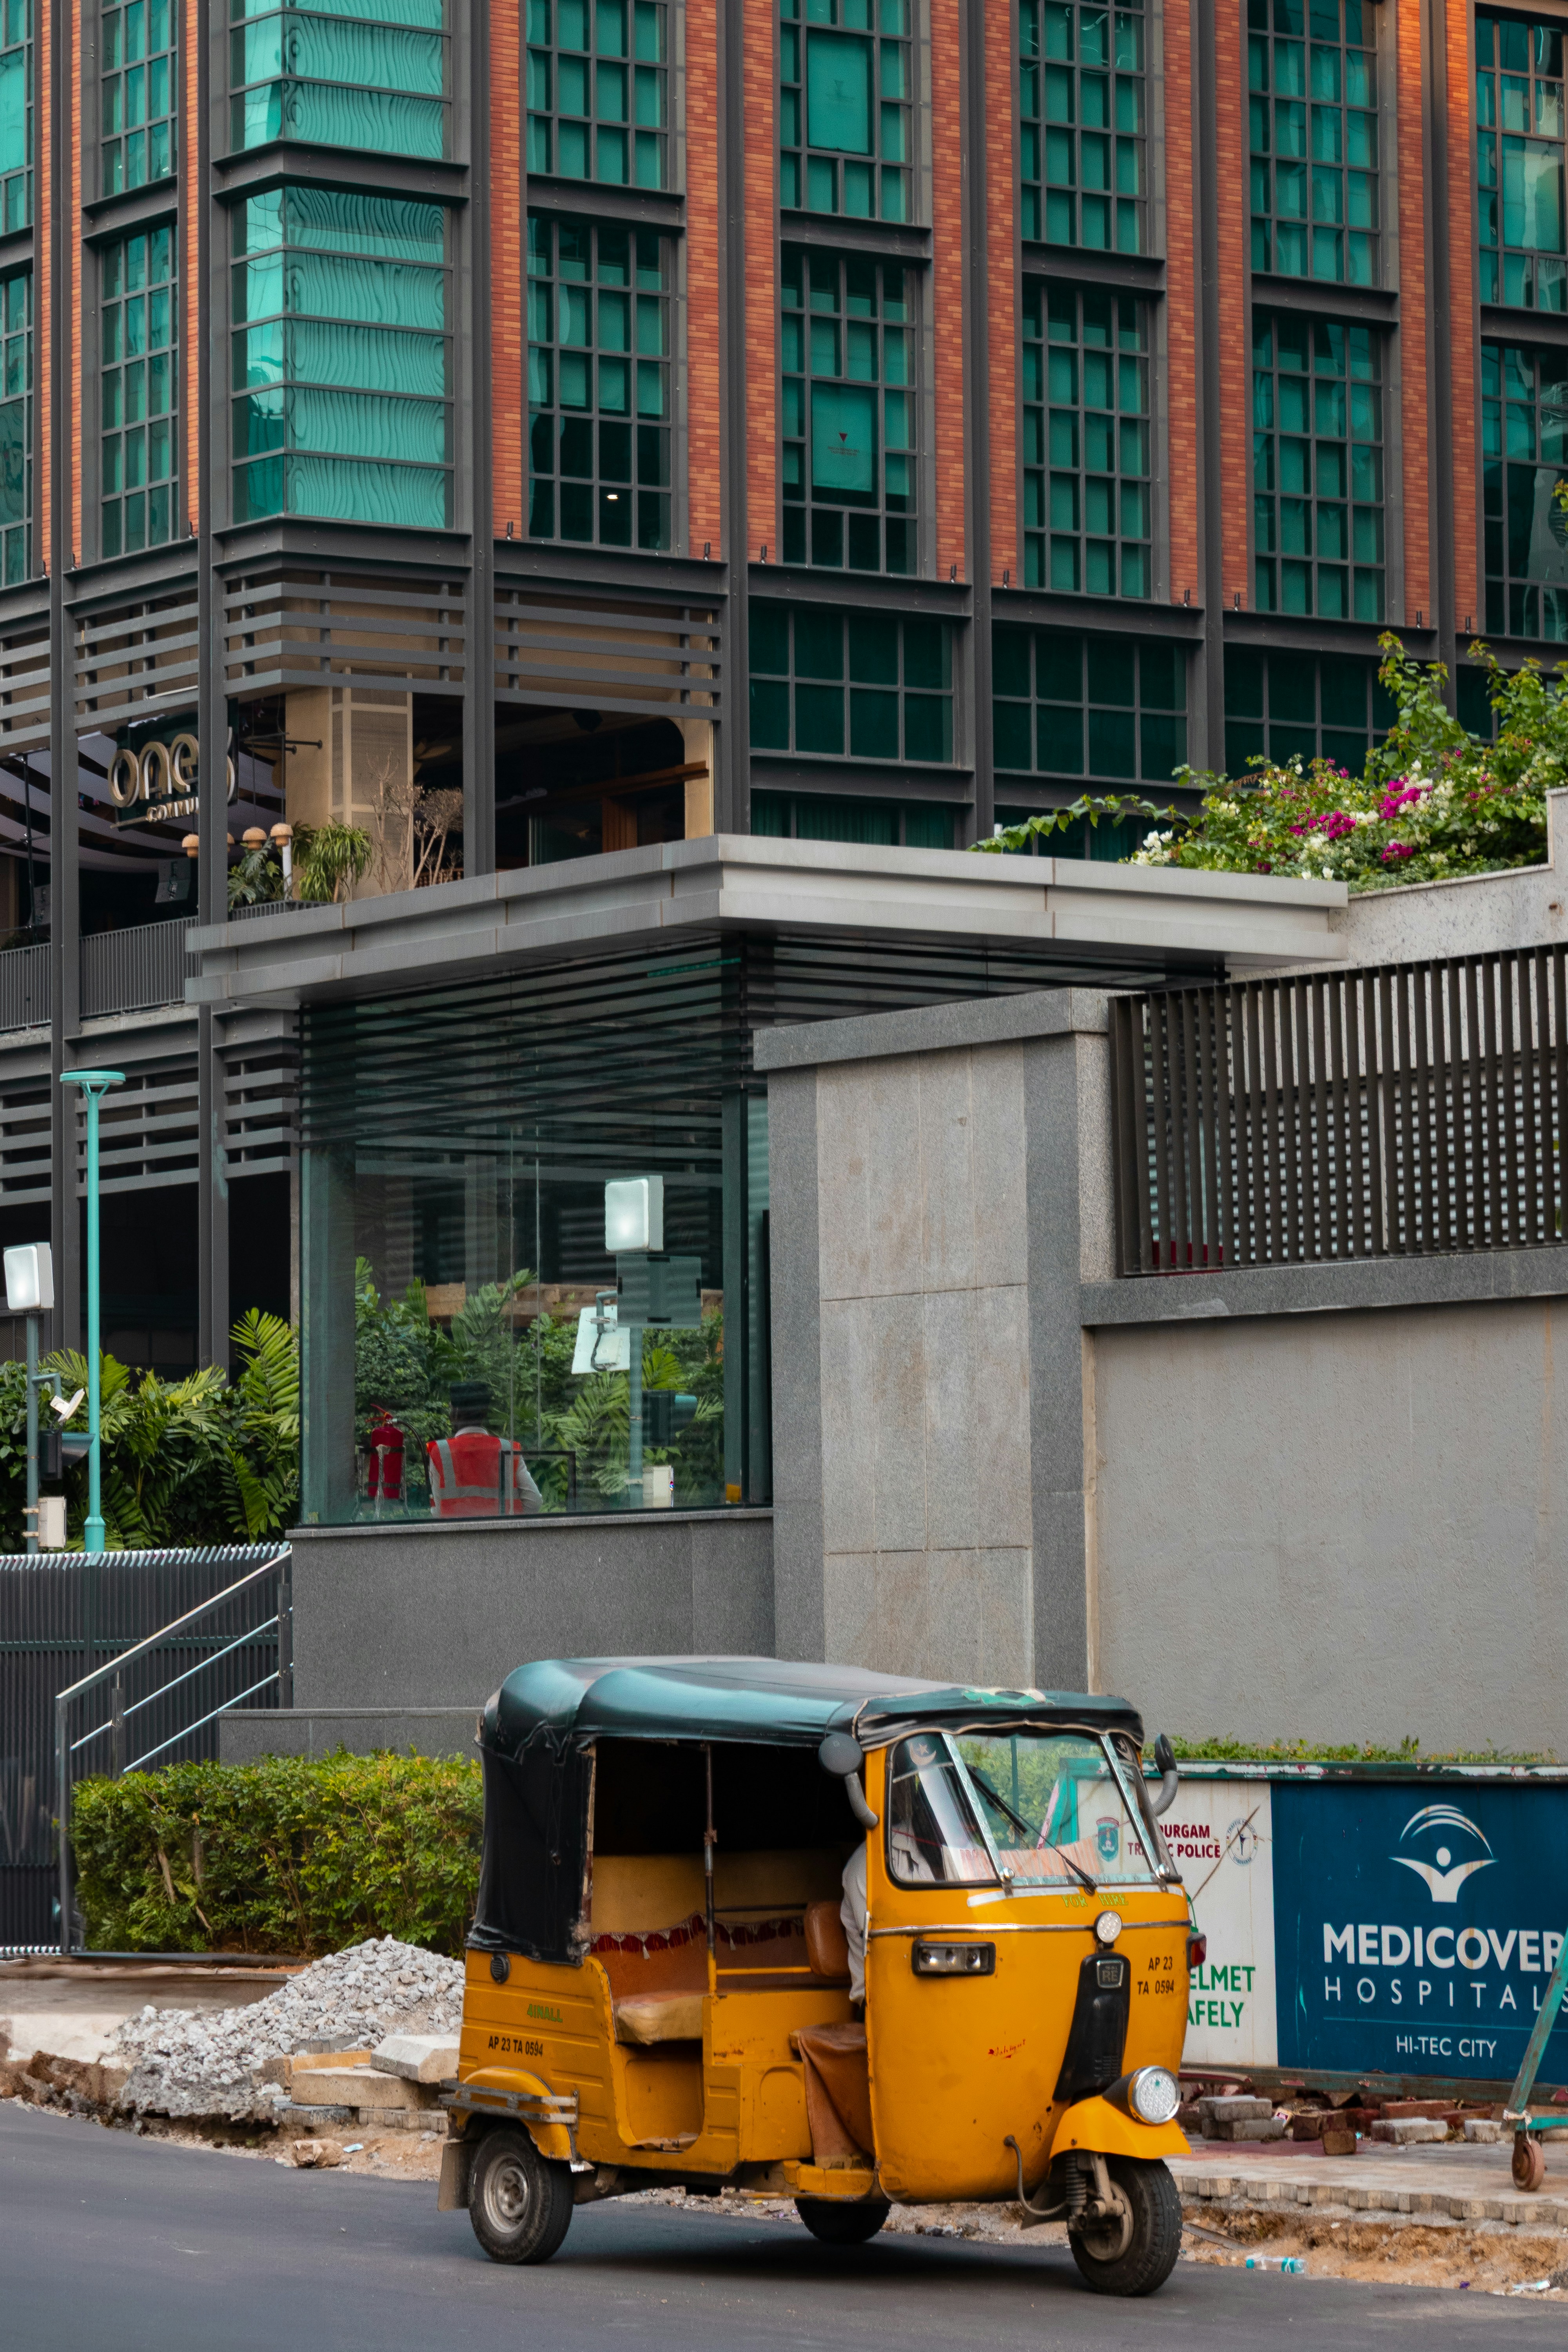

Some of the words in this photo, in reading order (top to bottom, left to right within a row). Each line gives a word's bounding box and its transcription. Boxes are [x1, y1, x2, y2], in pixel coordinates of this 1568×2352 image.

[108, 727, 235, 808] one
[147, 797, 199, 822] COMMU
[1177, 1844, 1221, 1858] POLICE
[1062, 1895, 1088, 1907] FOR
[1098, 1893, 1128, 1906] HIRE
[1323, 1923, 1564, 1973] MEDICOVER
[1148, 1956, 1160, 1971] AP
[1162, 1956, 1173, 1970] 23
[1137, 1981, 1149, 1994] TA
[1155, 1980, 1174, 1994] 0594
[488, 2036, 499, 2049] AP
[501, 2037, 510, 2052] 23
[513, 2039, 523, 2054] TA
[525, 2041, 543, 2057] 0594
[1396, 2035, 1452, 2056] HI-TEC
[1458, 2039, 1497, 2058] CITY
